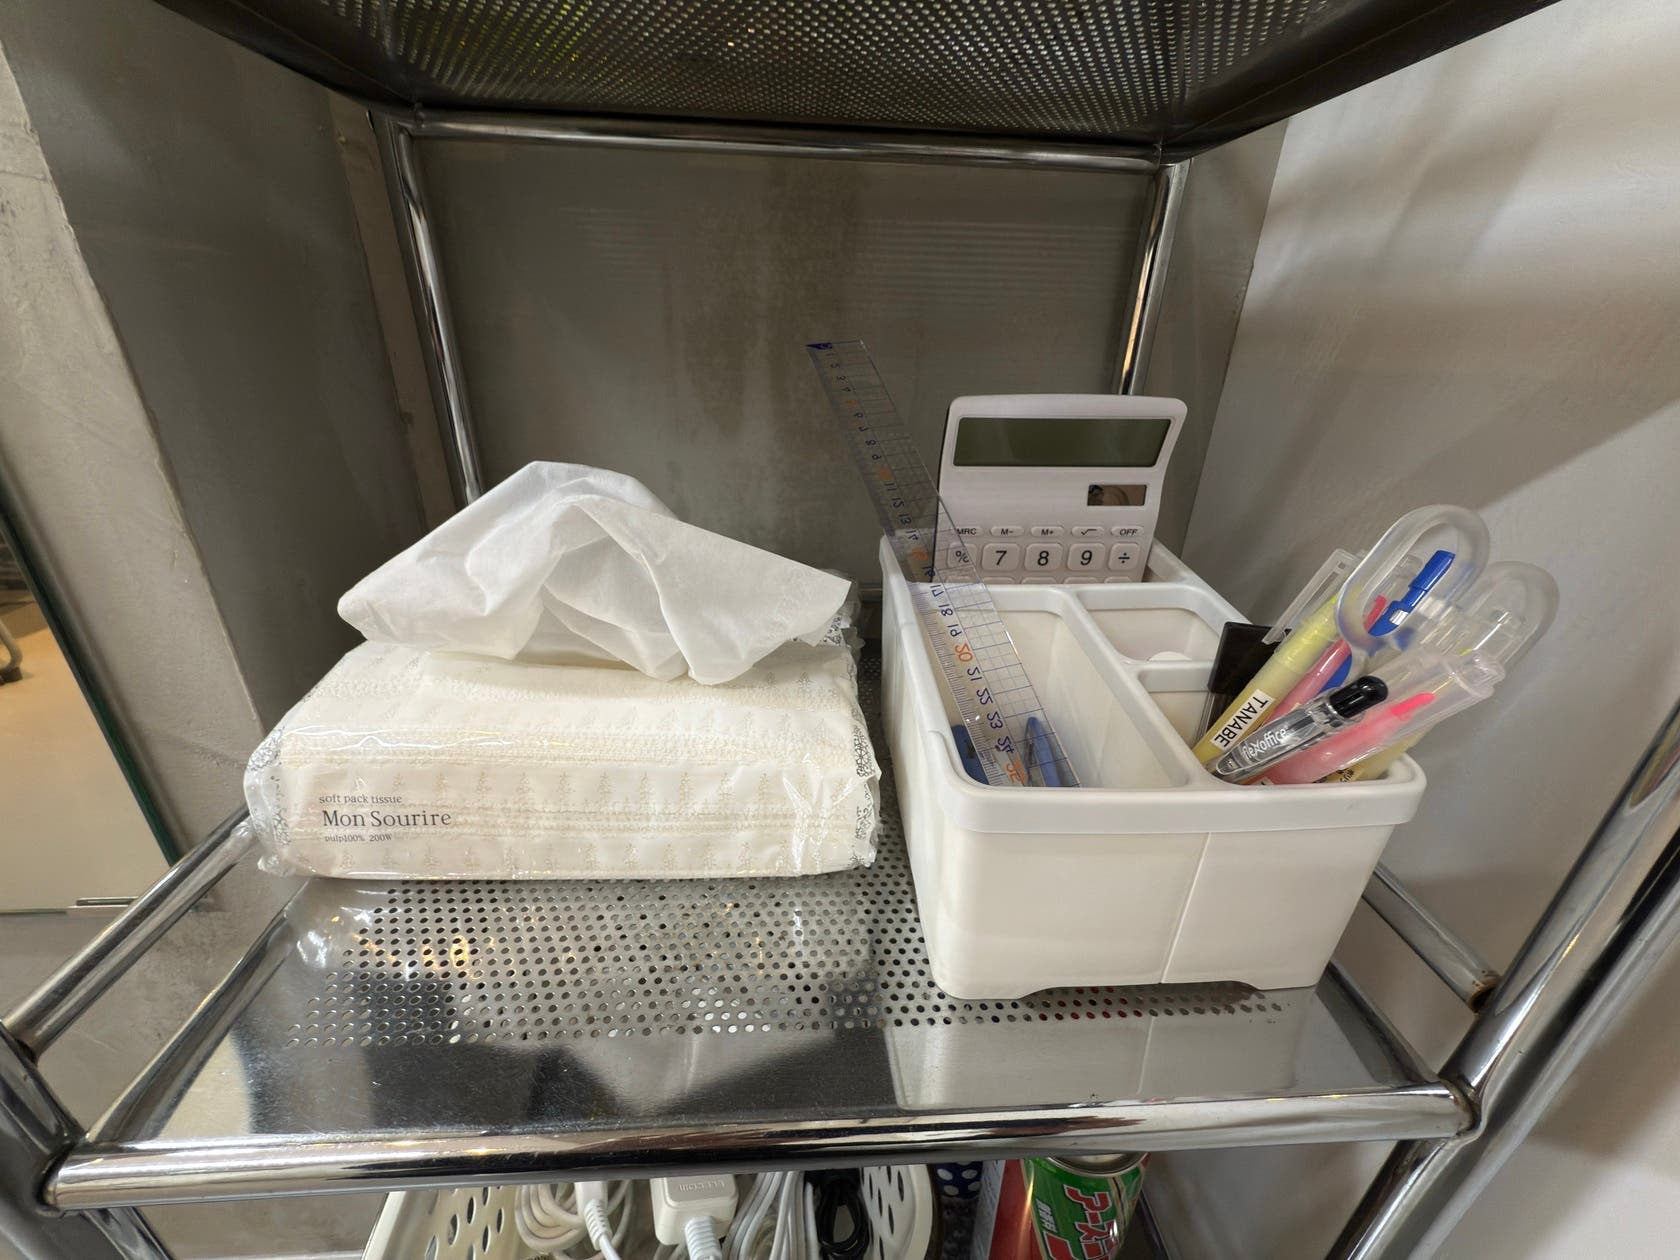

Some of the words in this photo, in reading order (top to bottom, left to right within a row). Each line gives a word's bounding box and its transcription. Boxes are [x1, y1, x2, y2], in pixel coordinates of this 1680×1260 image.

[956, 527, 977, 536] MRC
[1119, 528, 1138, 536] OFF
[994, 550, 1007, 566] 7
[1037, 550, 1050, 566] 8
[1080, 550, 1093, 566] 9
[1214, 696, 1268, 748] TANABE
[319, 794, 341, 804] soft
[343, 794, 369, 805] pack
[371, 794, 402, 804] tissue
[322, 810, 366, 827] Mon
[370, 810, 451, 827] Sourire
[369, 833, 393, 842] 200W
